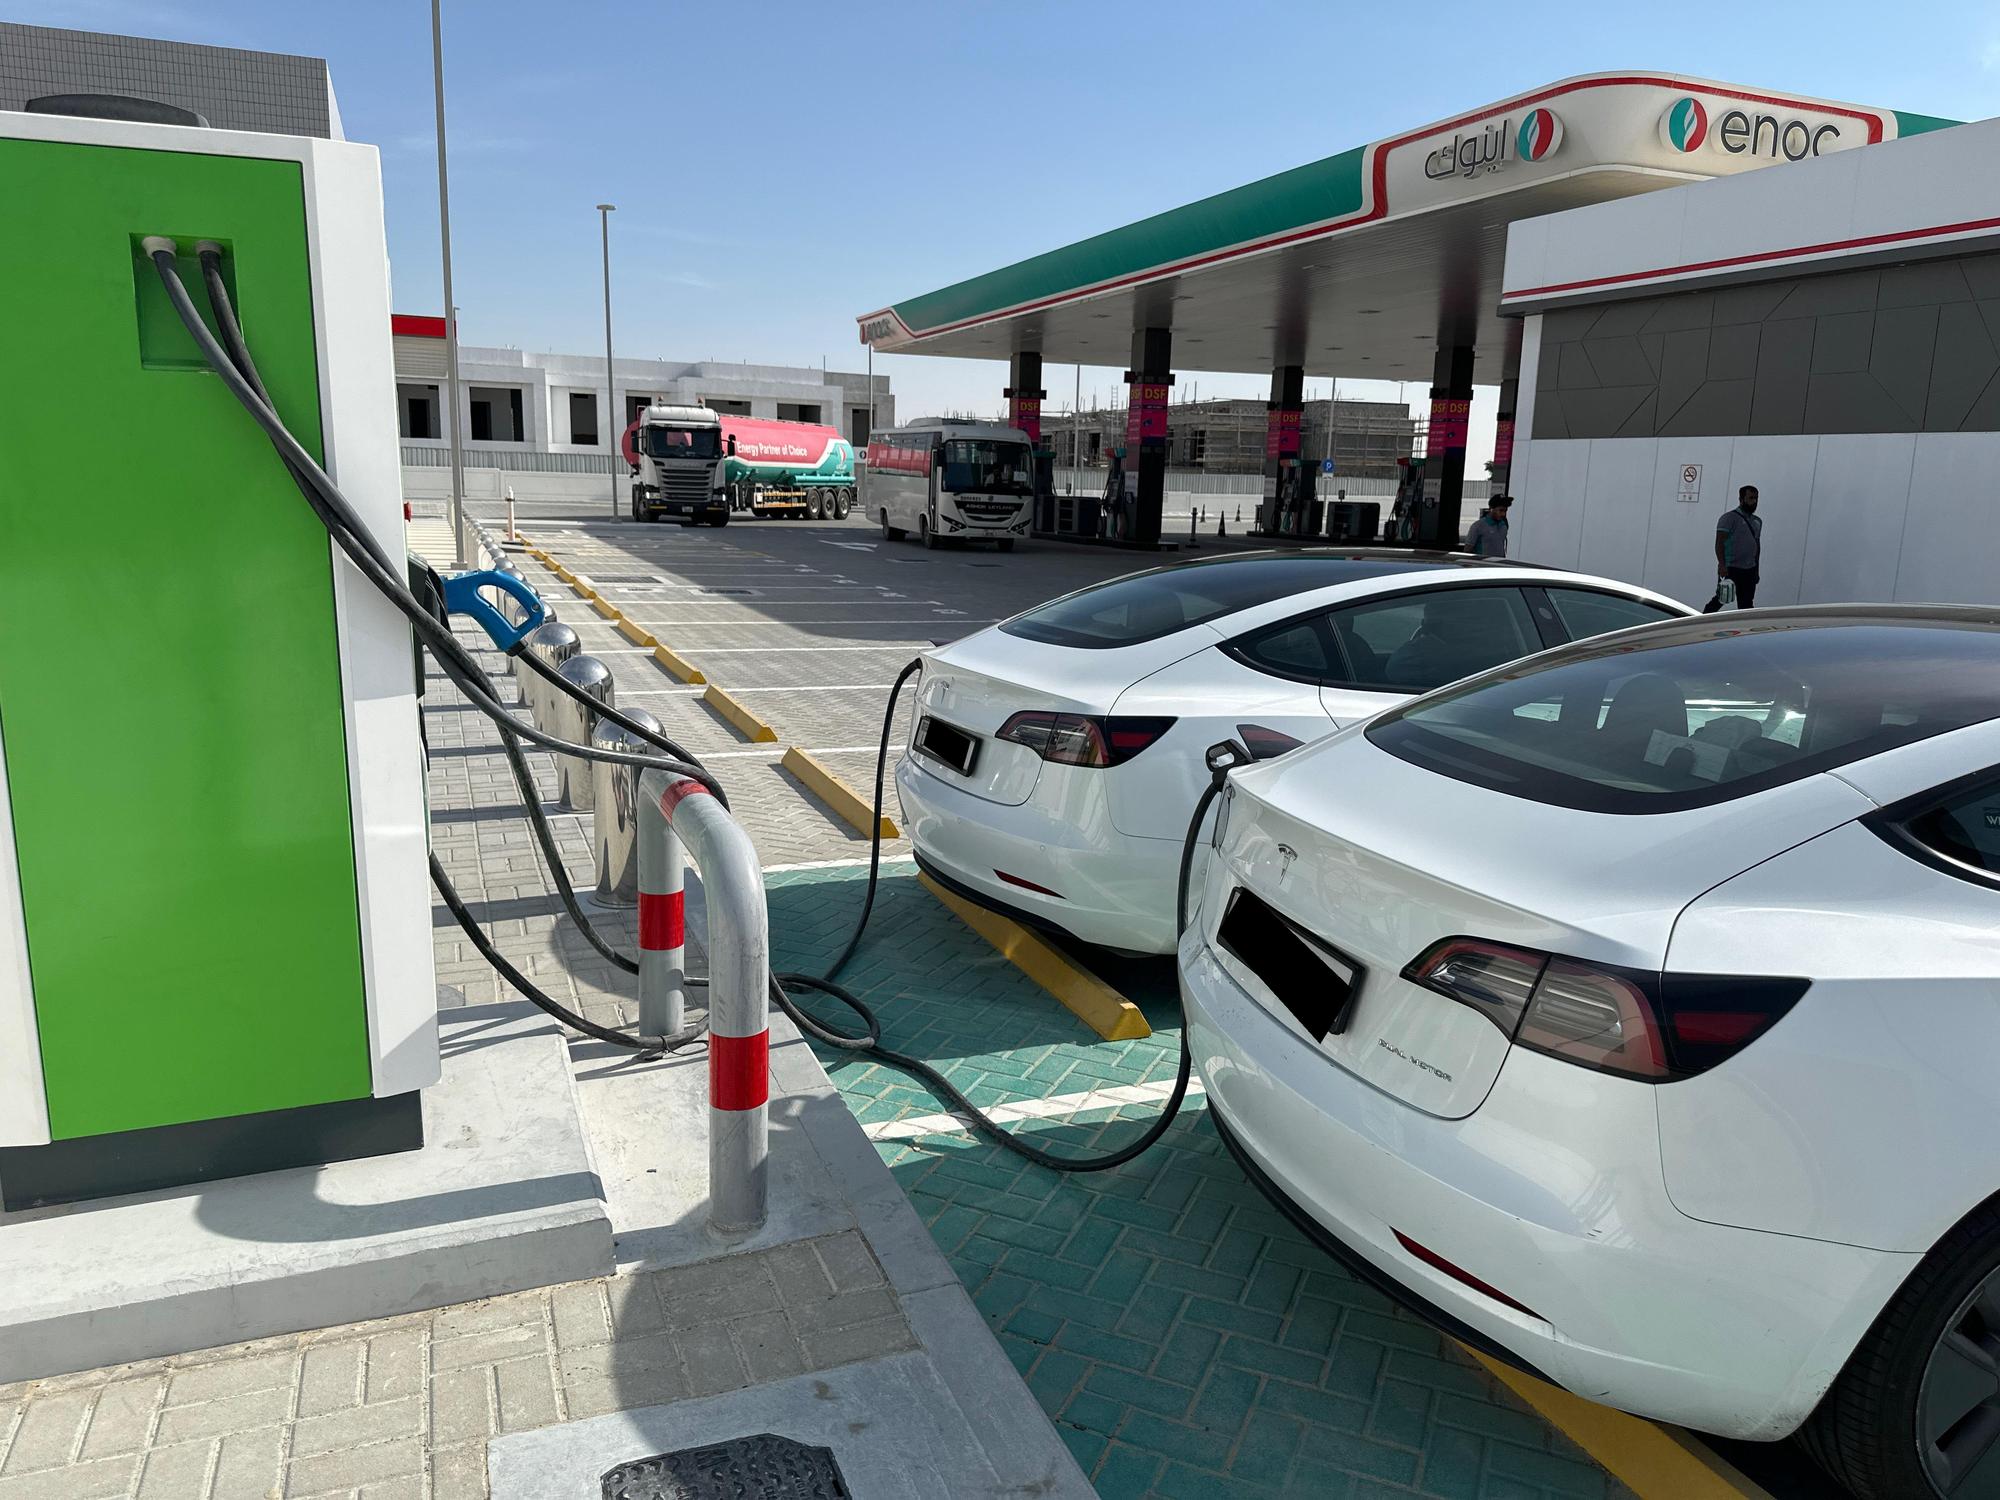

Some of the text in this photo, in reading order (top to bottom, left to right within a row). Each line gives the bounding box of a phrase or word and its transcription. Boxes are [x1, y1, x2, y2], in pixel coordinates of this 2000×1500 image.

[1721, 110, 1841, 162] enoc
[1144, 388, 1166, 400] DSF
[1020, 402, 1039, 411] DSF
[1450, 403, 1468, 414] DSF
[1283, 414, 1298, 423] DSF
[736, 441, 808, 457] Energy Partner of Choice
[1378, 1039, 1452, 1082] DUAL MOTOR
